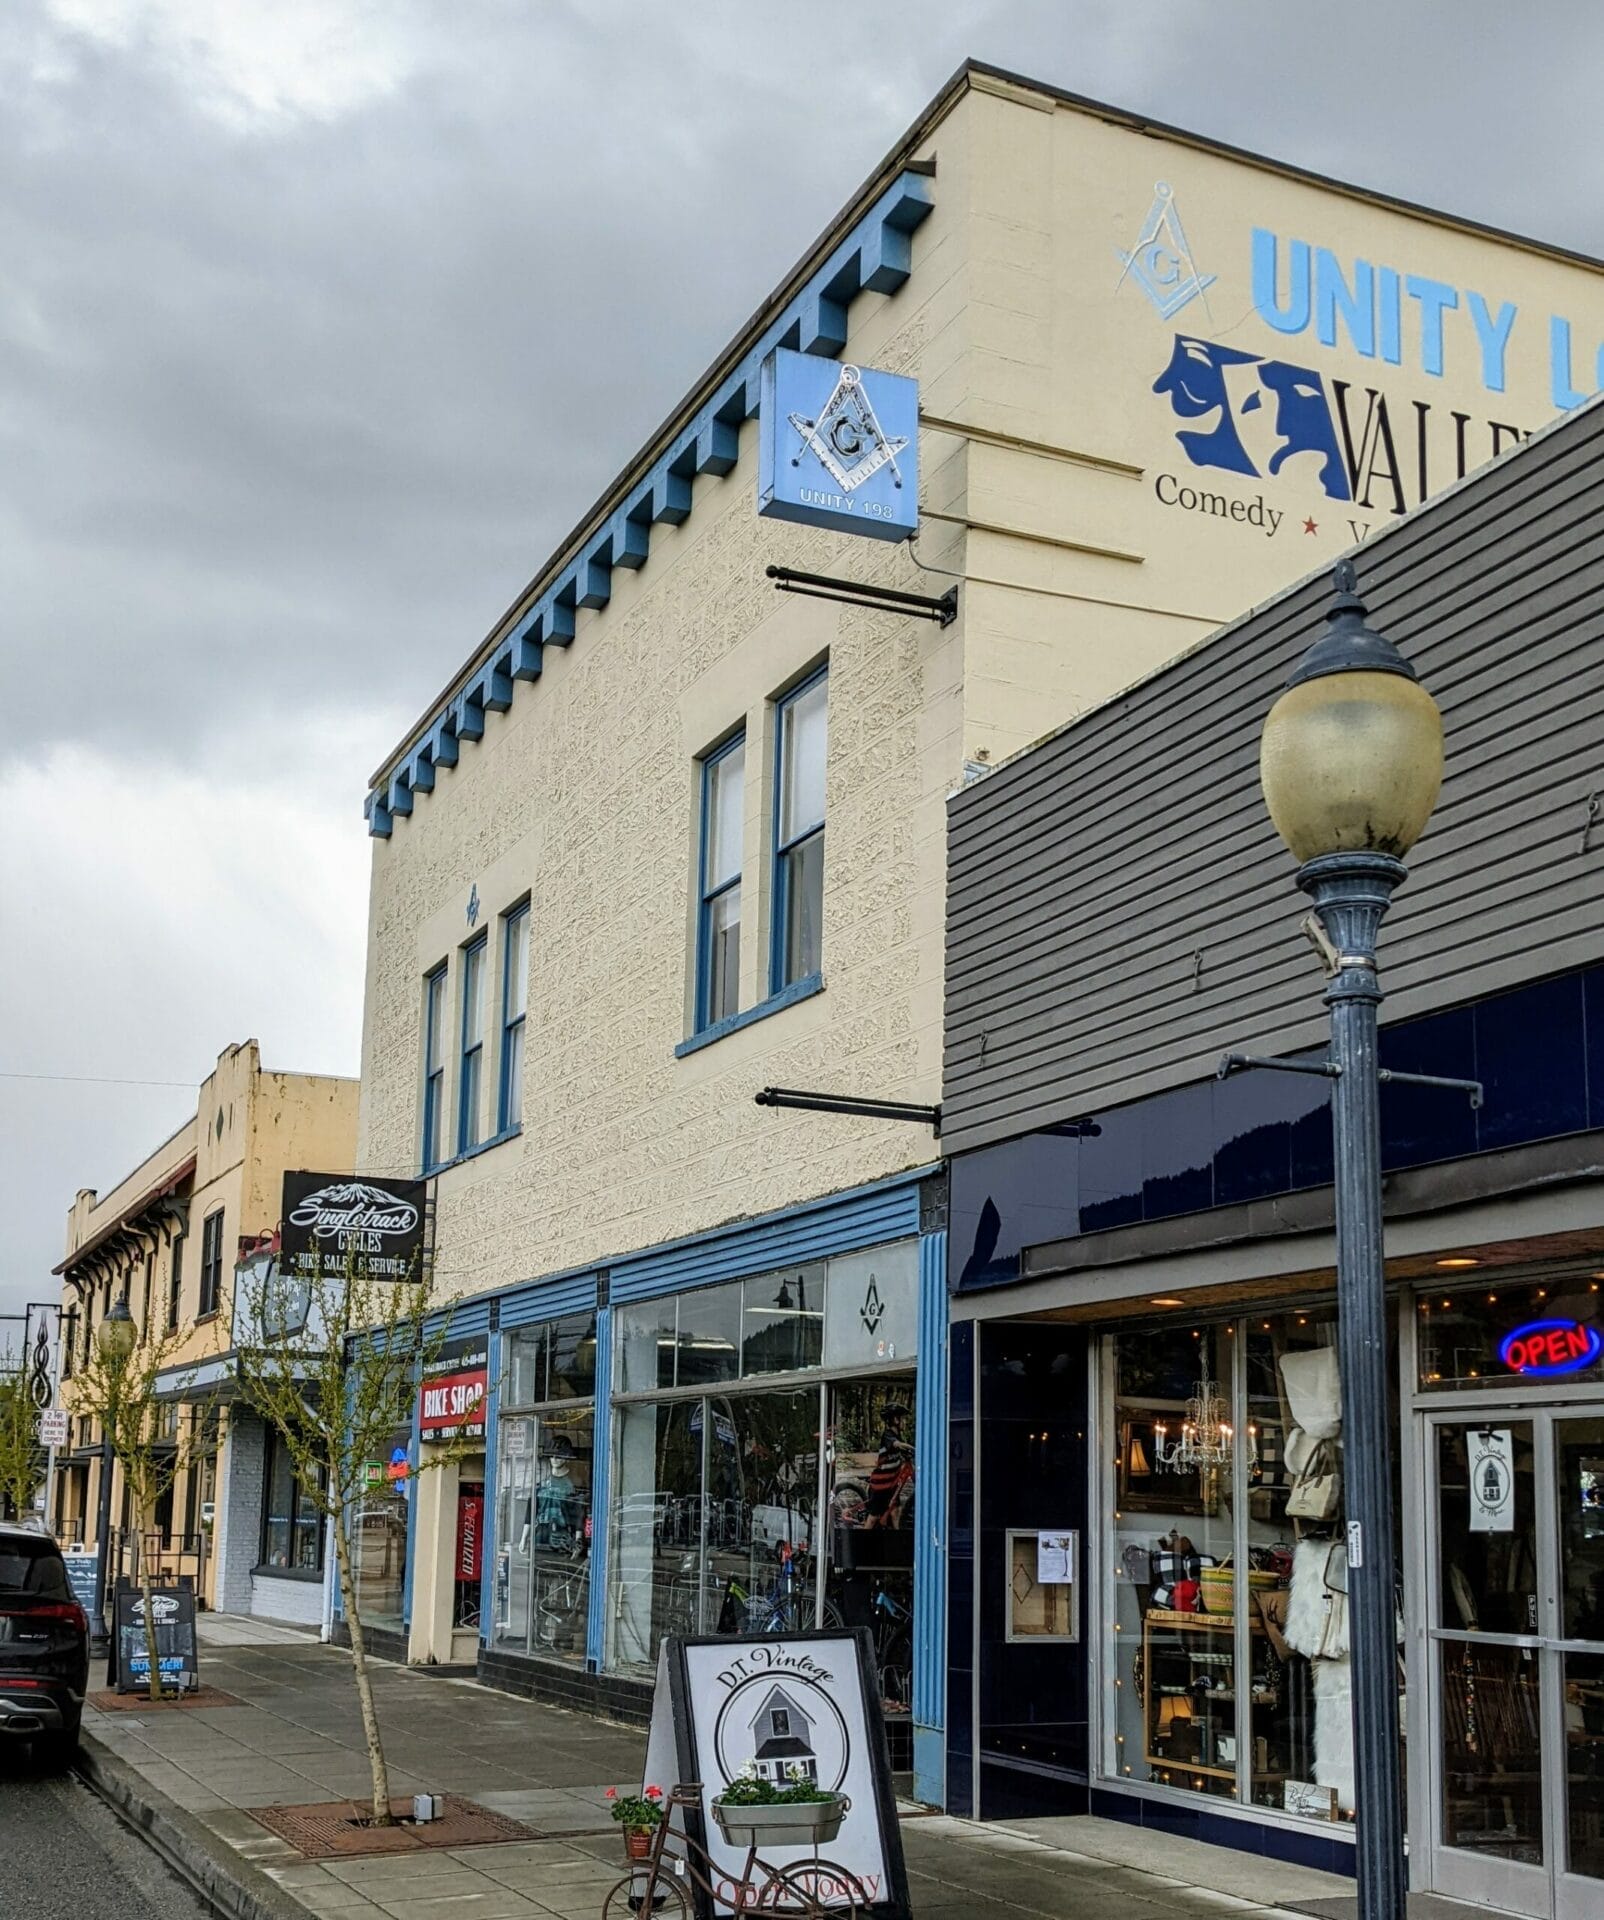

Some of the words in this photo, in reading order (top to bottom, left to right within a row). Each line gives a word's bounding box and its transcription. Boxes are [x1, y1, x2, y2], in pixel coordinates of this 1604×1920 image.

[1250, 227, 1518, 393] UNITY
[800, 488, 855, 511] UNITY
[863, 502, 894, 519] 198
[1155, 474, 1284, 537] Comedy
[289, 1198, 418, 1237] Singletrack
[324, 1254, 353, 1272] SALE
[1506, 1325, 1590, 1370] OPEN
[424, 1387, 449, 1418] BIKE
[716, 1658, 754, 1689] D.T.
[750, 1644, 834, 1686] Vintage
